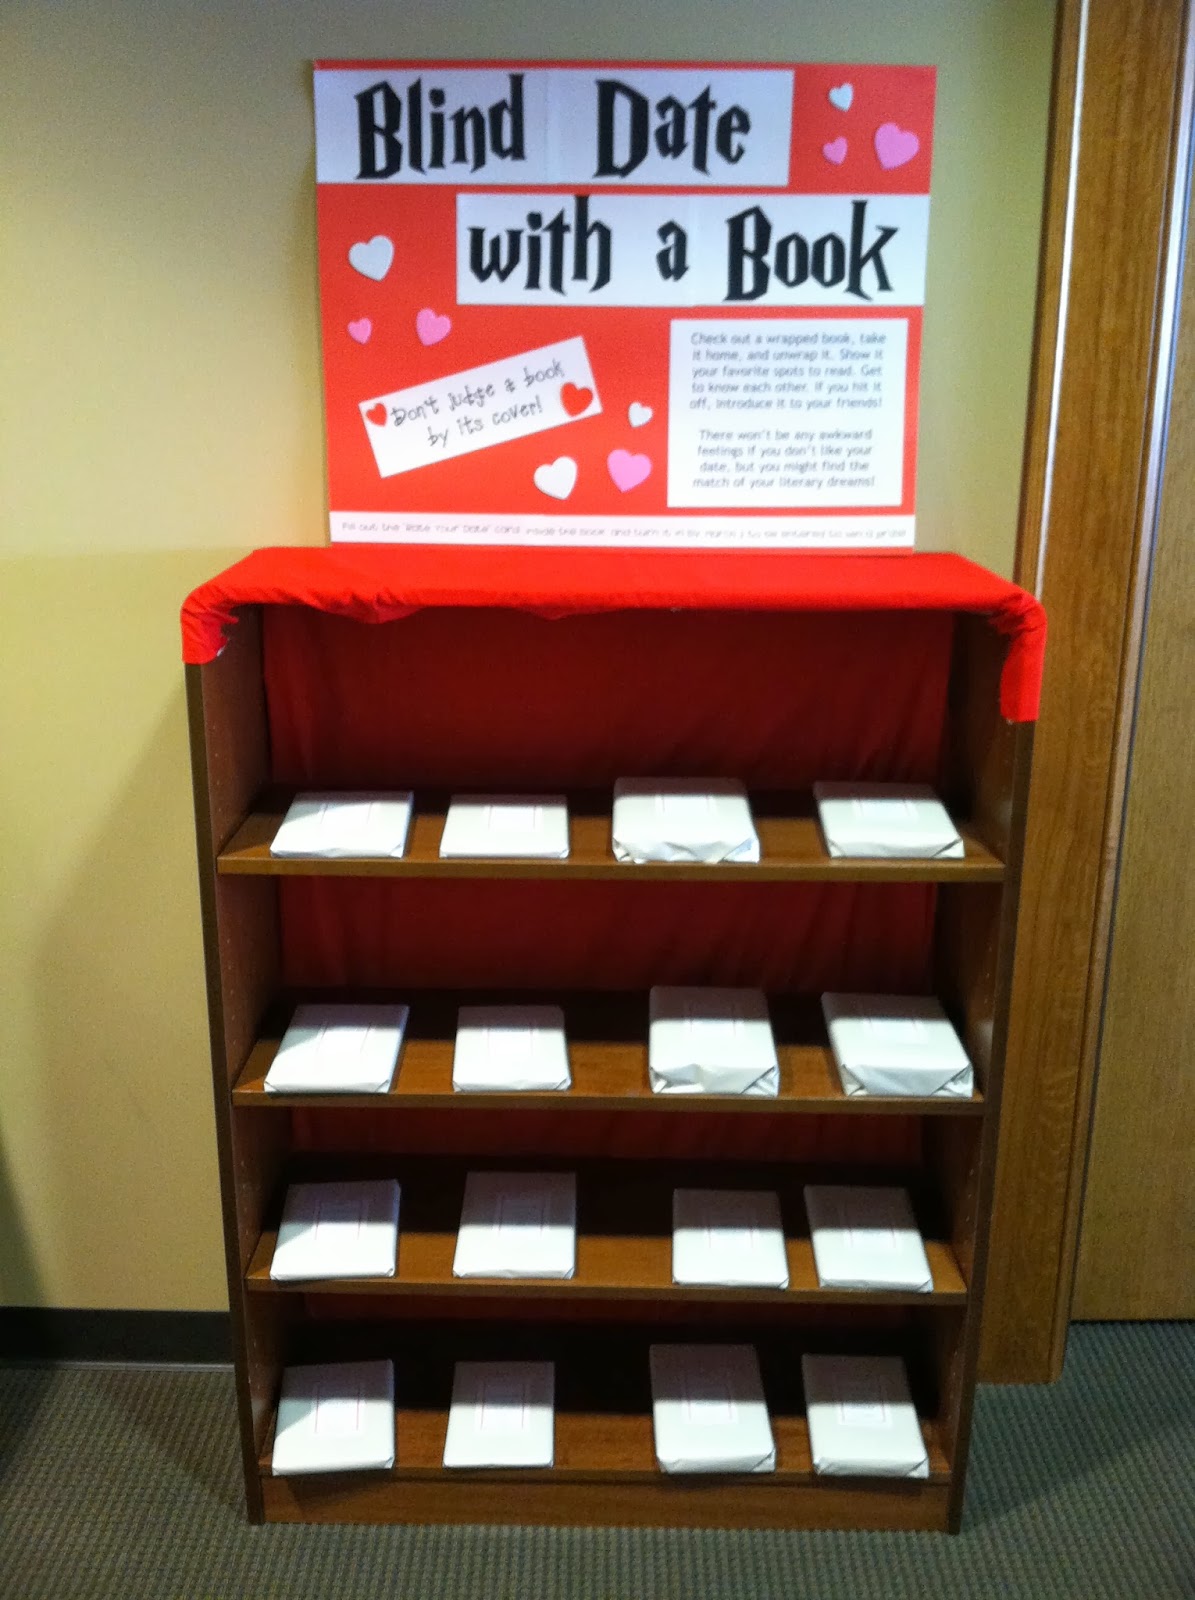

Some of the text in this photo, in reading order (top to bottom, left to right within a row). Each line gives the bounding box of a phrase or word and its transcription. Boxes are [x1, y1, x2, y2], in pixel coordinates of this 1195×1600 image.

[354, 72, 752, 180] Blind Date
[467, 194, 900, 303] with a Book
[690, 332, 886, 346] Check out a wrapped book, take
[693, 348, 883, 362] it home, and unwrap it. Show it
[692, 364, 882, 378] your favorite spots to read. Get
[692, 381, 881, 394] to know each other. If you hit it
[690, 397, 882, 411] off, introduce it to your friends!
[428, 395, 543, 448] by its cover!
[700, 429, 873, 442] There won't be any awkward
[697, 445, 872, 459] feelings if you don't like your
[700, 461, 869, 474] date, but you might find the
[693, 476, 875, 490] match of your literary dreams!
